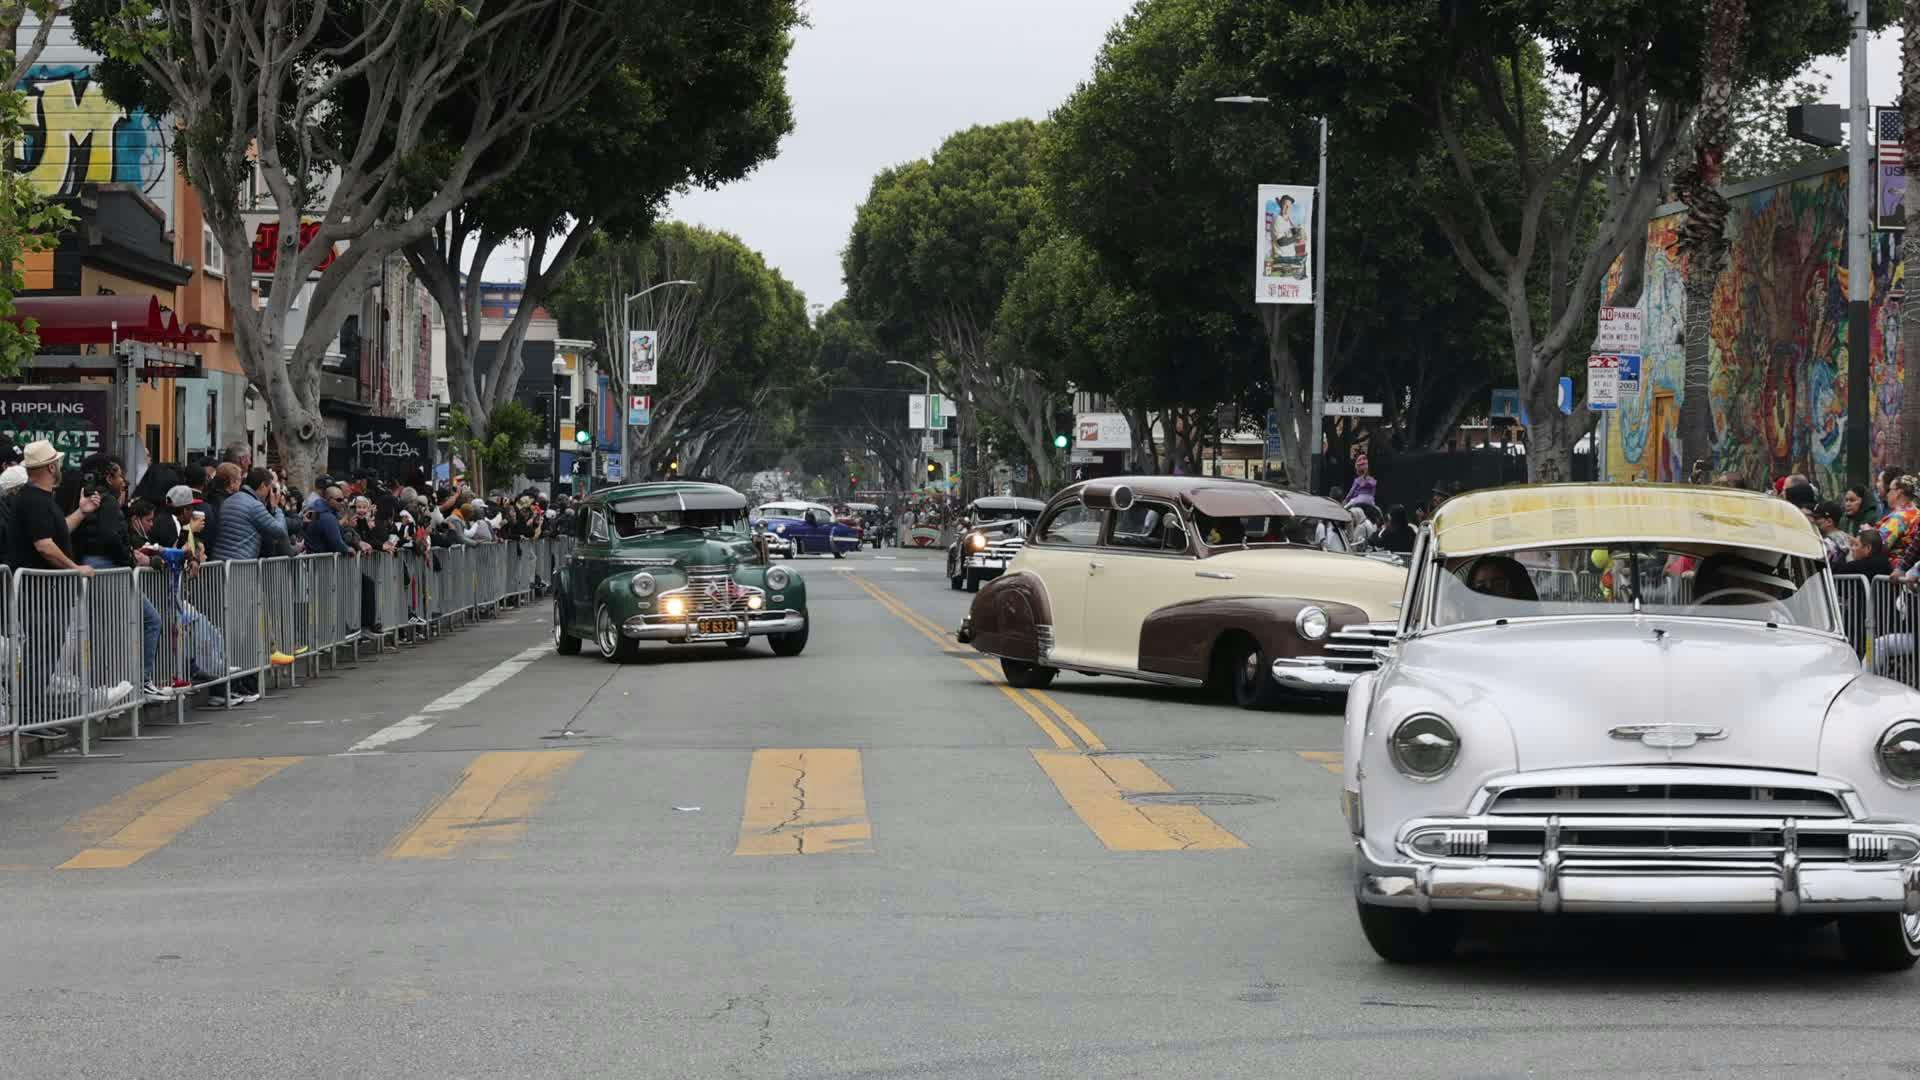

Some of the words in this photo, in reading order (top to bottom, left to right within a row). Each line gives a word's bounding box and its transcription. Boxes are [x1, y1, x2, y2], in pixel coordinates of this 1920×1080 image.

[1601, 308, 1613, 320] NO
[1614, 311, 1641, 321] PARKING
[11, 402, 85, 414] RIPPLING
[1341, 405, 1366, 414] Lilac
